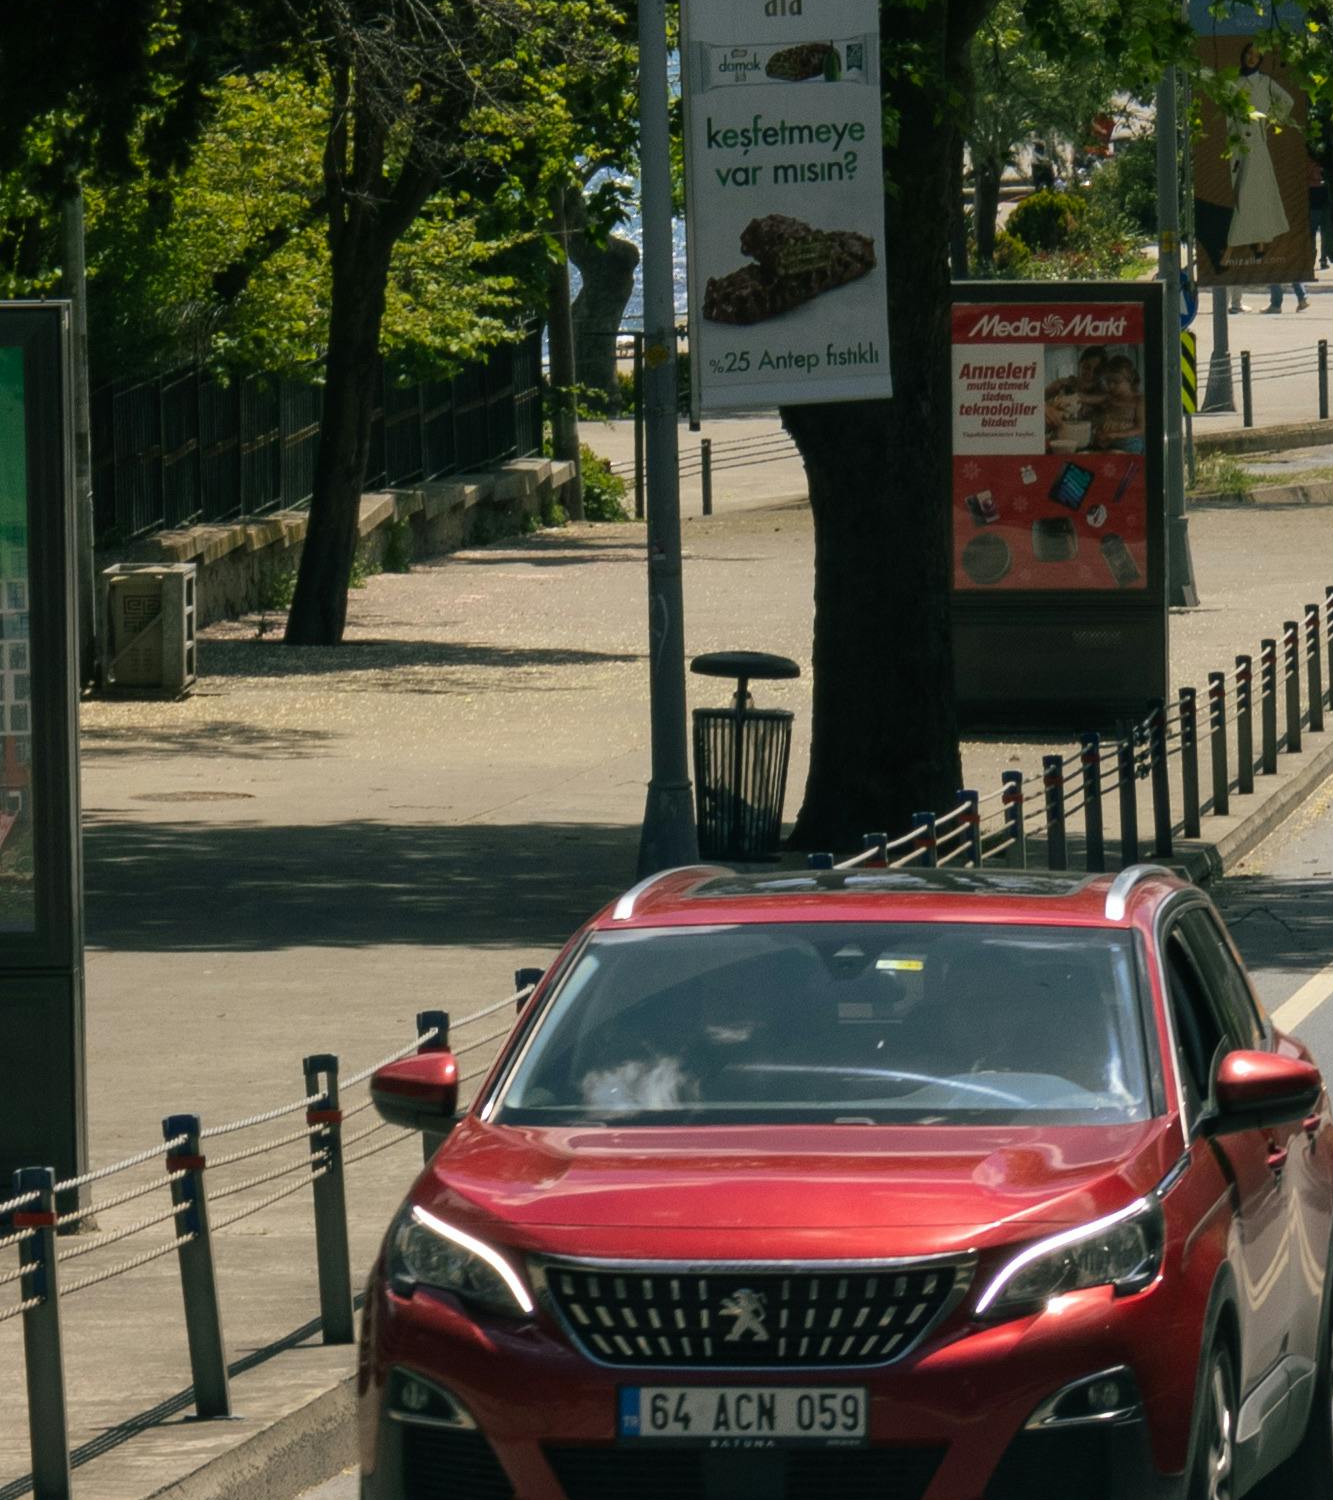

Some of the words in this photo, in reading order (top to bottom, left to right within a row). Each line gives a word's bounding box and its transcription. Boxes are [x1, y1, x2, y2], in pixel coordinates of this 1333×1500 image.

[706, 114, 865, 156] keşfetmeye
[715, 165, 763, 187] var
[773, 150, 858, 185] mısın?
[968, 314, 1041, 337] Media
[1060, 314, 1127, 337] Markt
[709, 351, 751, 374] %25
[757, 349, 819, 373] Antep
[826, 342, 879, 367] fıstıklı
[959, 362, 1037, 380] Anneleri
[966, 381, 997, 391] mutlu
[997, 381, 1029, 391] etmek
[959, 403, 1037, 418] teknolojiler
[981, 417, 1017, 428] bizden!
[650, 1393, 692, 1431] 64
[712, 1393, 776, 1431] ACN
[797, 1393, 860, 1431] 059
